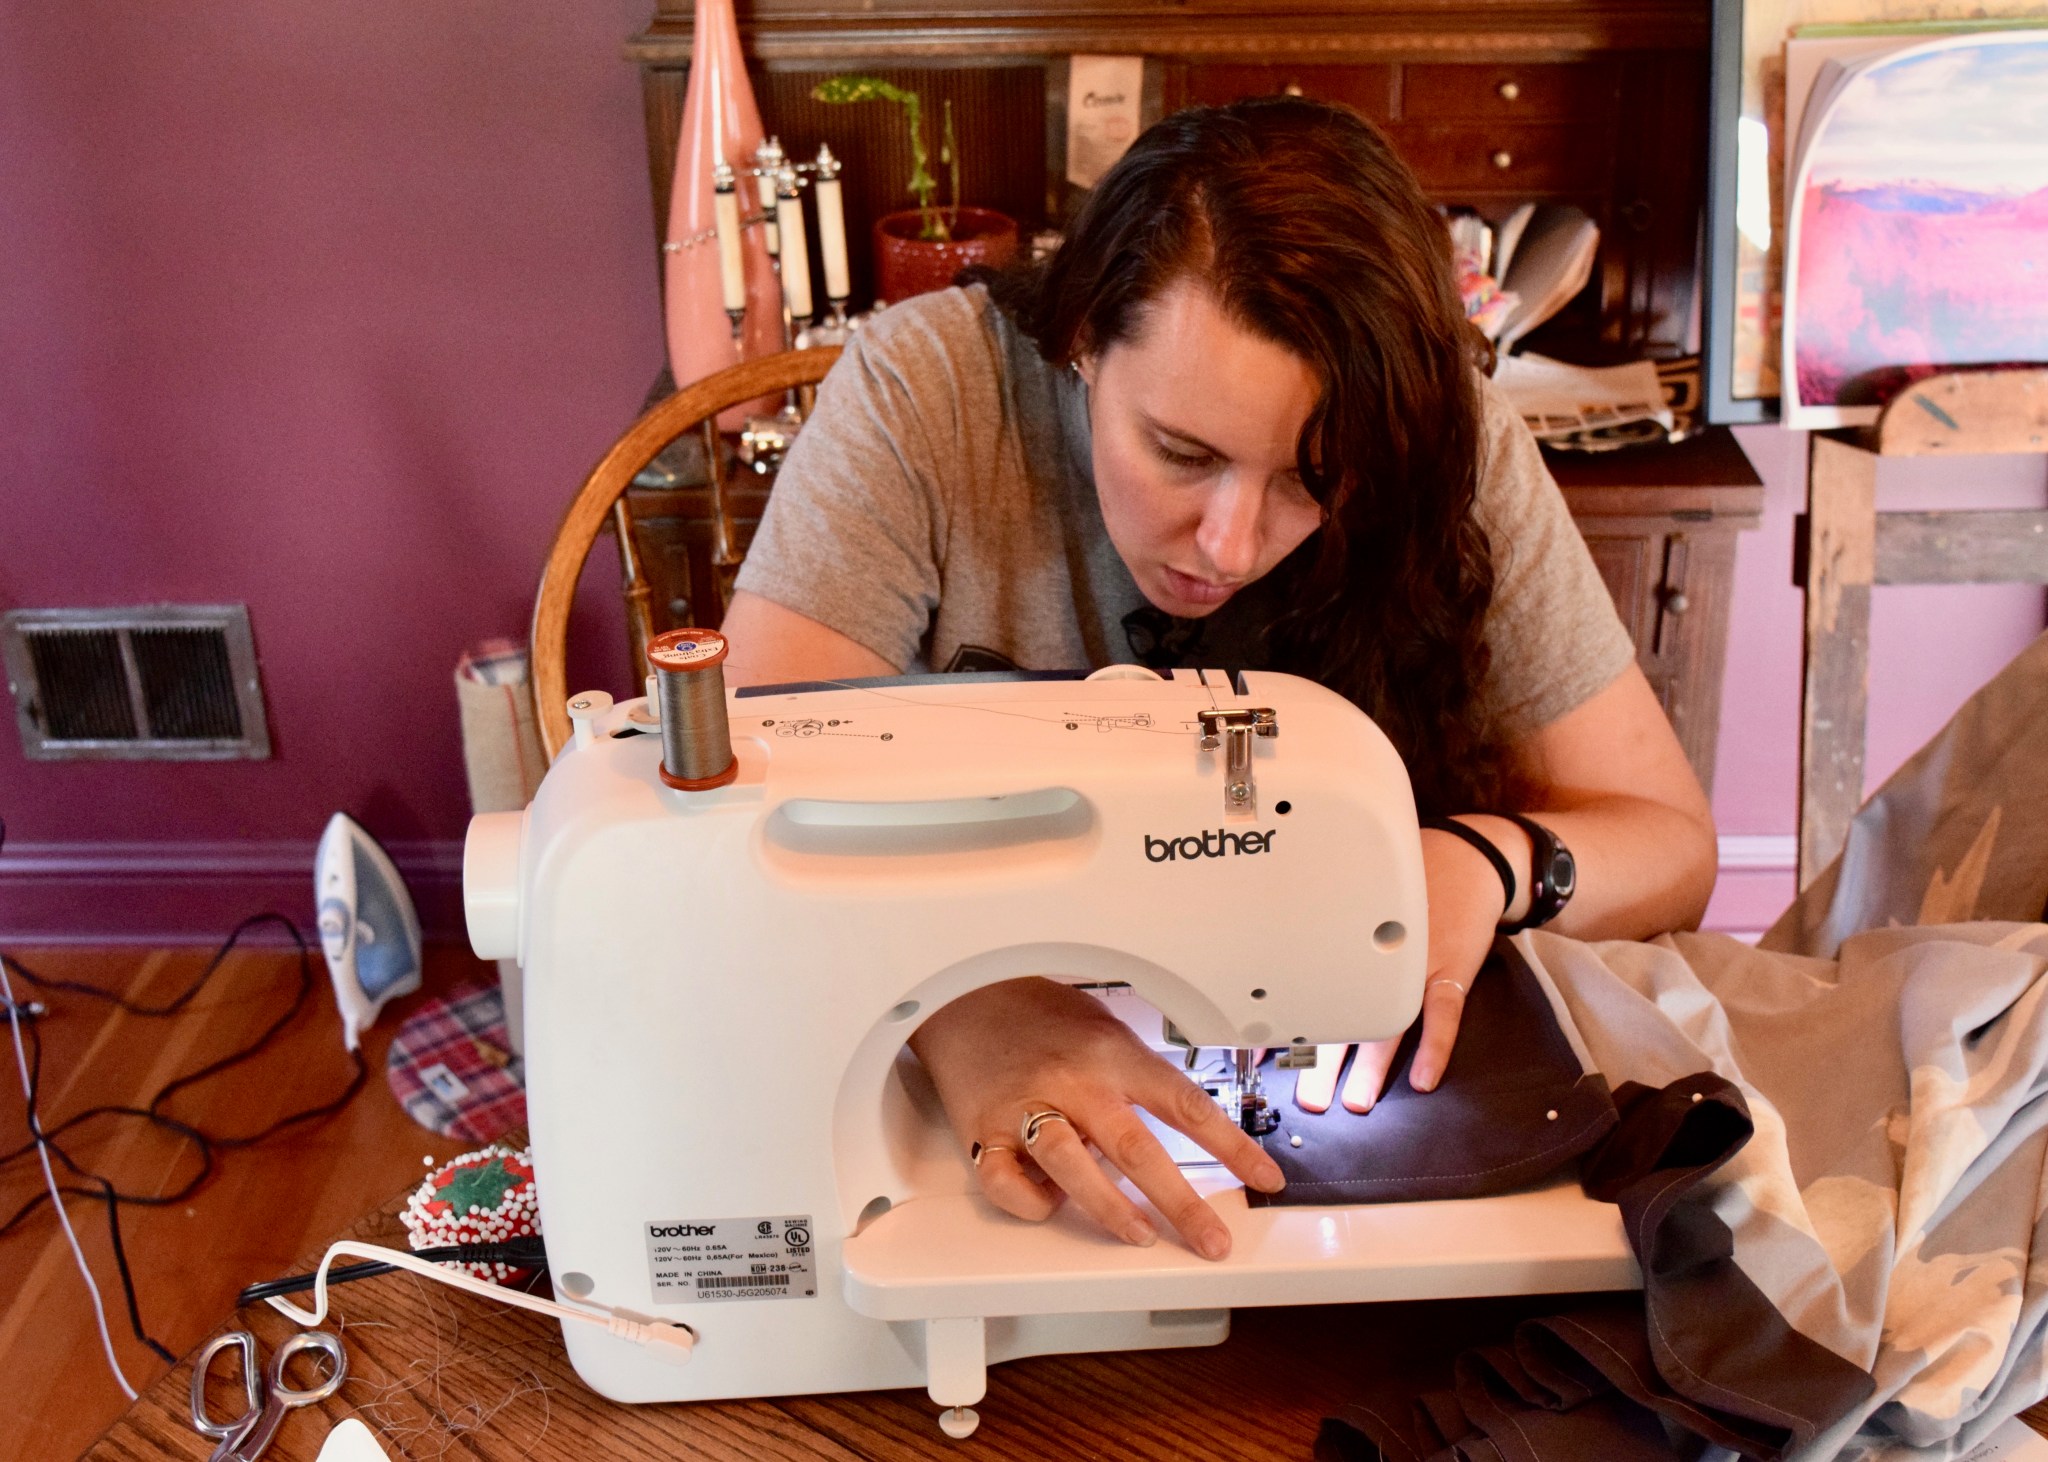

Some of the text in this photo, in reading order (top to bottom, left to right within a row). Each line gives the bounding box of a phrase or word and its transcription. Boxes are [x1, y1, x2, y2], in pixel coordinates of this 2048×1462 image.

[1144, 828, 1276, 862] brother
[650, 1224, 716, 1237] brother
[698, 1288, 788, 1298] U61530-J5G205074
